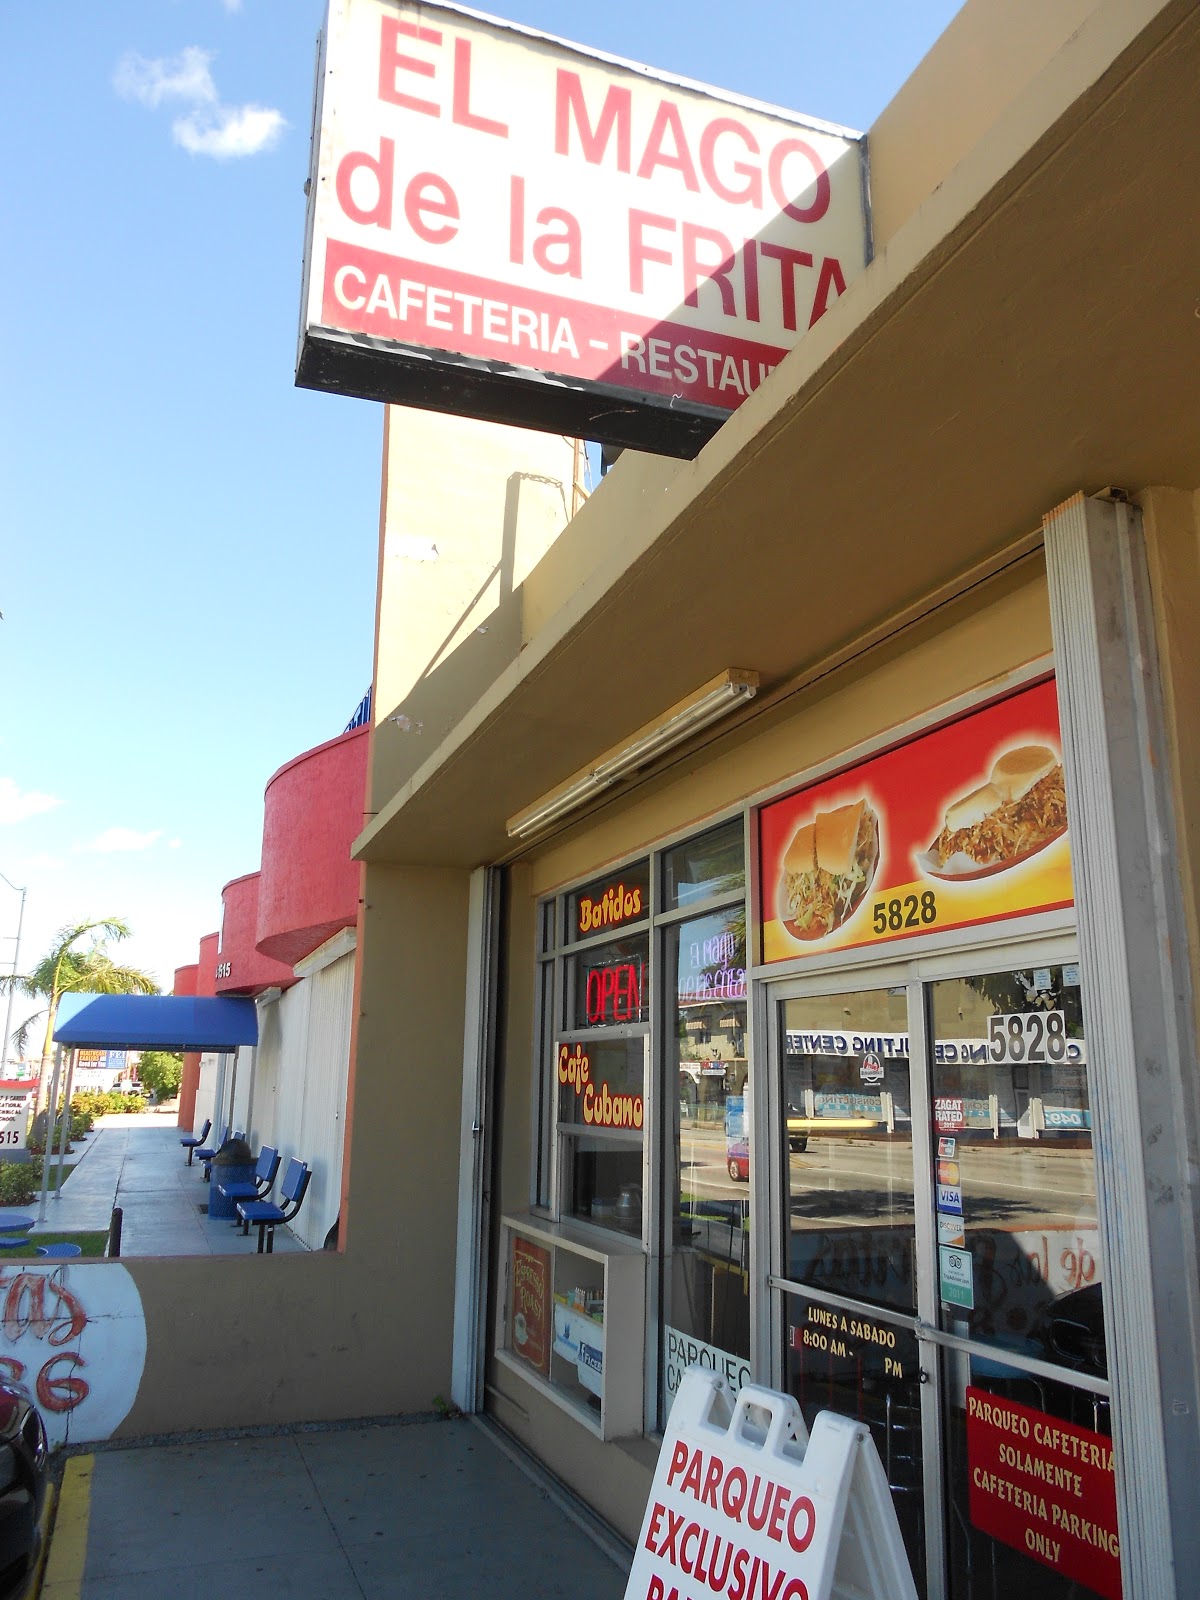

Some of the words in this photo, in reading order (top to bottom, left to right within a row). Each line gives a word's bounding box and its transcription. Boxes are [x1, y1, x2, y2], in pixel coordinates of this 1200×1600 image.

[377, 14, 508, 139] EL
[554, 68, 831, 224] MAGO
[335, 136, 461, 245] de
[509, 175, 583, 280] la
[628, 207, 847, 332] FRITA
[333, 264, 580, 360] CAFETERIA
[620, 331, 776, 397] RESTAU
[580, 884, 641, 933] Batidos
[873, 890, 937, 934] 5828
[586, 962, 644, 1023] OPEN
[990, 1012, 1066, 1062] 5828
[582, 1082, 643, 1129] Cubano
[935, 1099, 962, 1110] ZAGAT
[935, 1110, 962, 1122] RATED
[941, 1191, 960, 1204] VISA
[808, 1306, 838, 1329] LUNES
[840, 1316, 848, 1333] A
[850, 1320, 896, 1348] SABADO
[803, 1329, 828, 1351] 8:00
[830, 1339, 846, 1358] AM
[884, 1357, 903, 1379] PM
[968, 1396, 1030, 1438] PARQUEO
[1033, 1422, 1115, 1473] CAFETERIA
[998, 1443, 1083, 1498] SOLAMENTE
[666, 1440, 816, 1553] PARQUEO
[973, 1467, 1048, 1521] CAFETERIA
[1051, 1503, 1120, 1558] PARKING
[1025, 1528, 1061, 1563] ONLY
